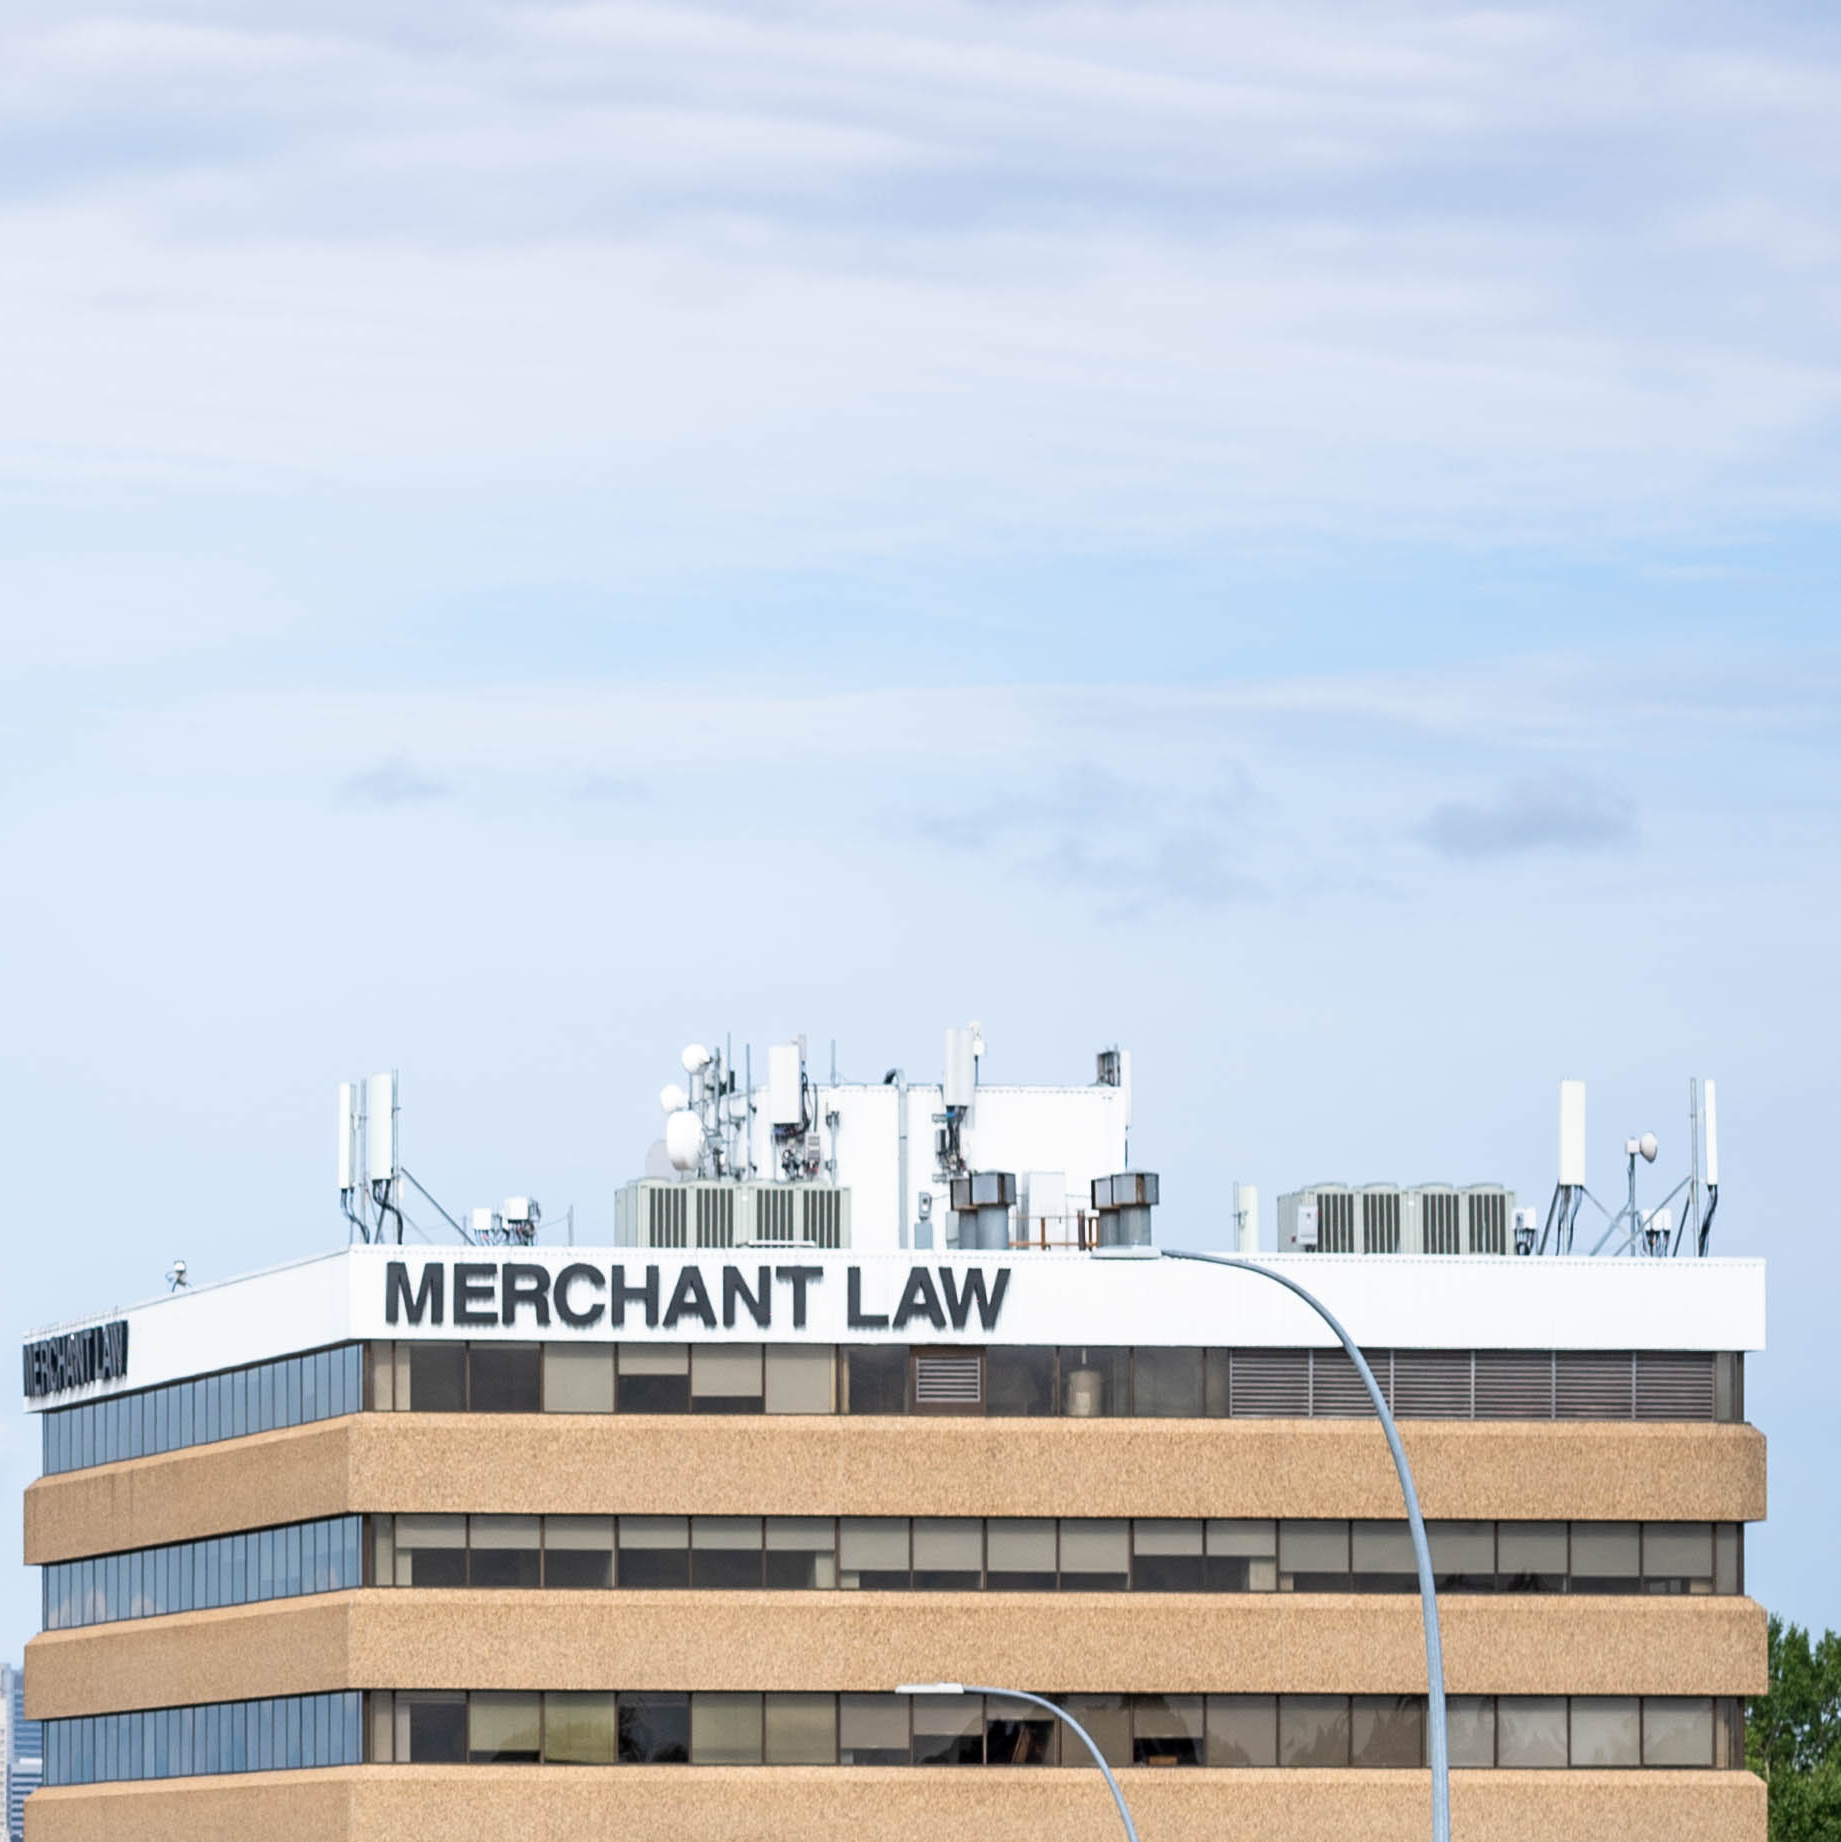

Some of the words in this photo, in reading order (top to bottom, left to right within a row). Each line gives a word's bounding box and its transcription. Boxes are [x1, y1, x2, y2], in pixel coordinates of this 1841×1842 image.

[384, 1261, 824, 1329] MERCHANT
[846, 1266, 1012, 1331] LAW
[22, 1326, 95, 1398] MERCHANT
[93, 1319, 129, 1381] LAW
